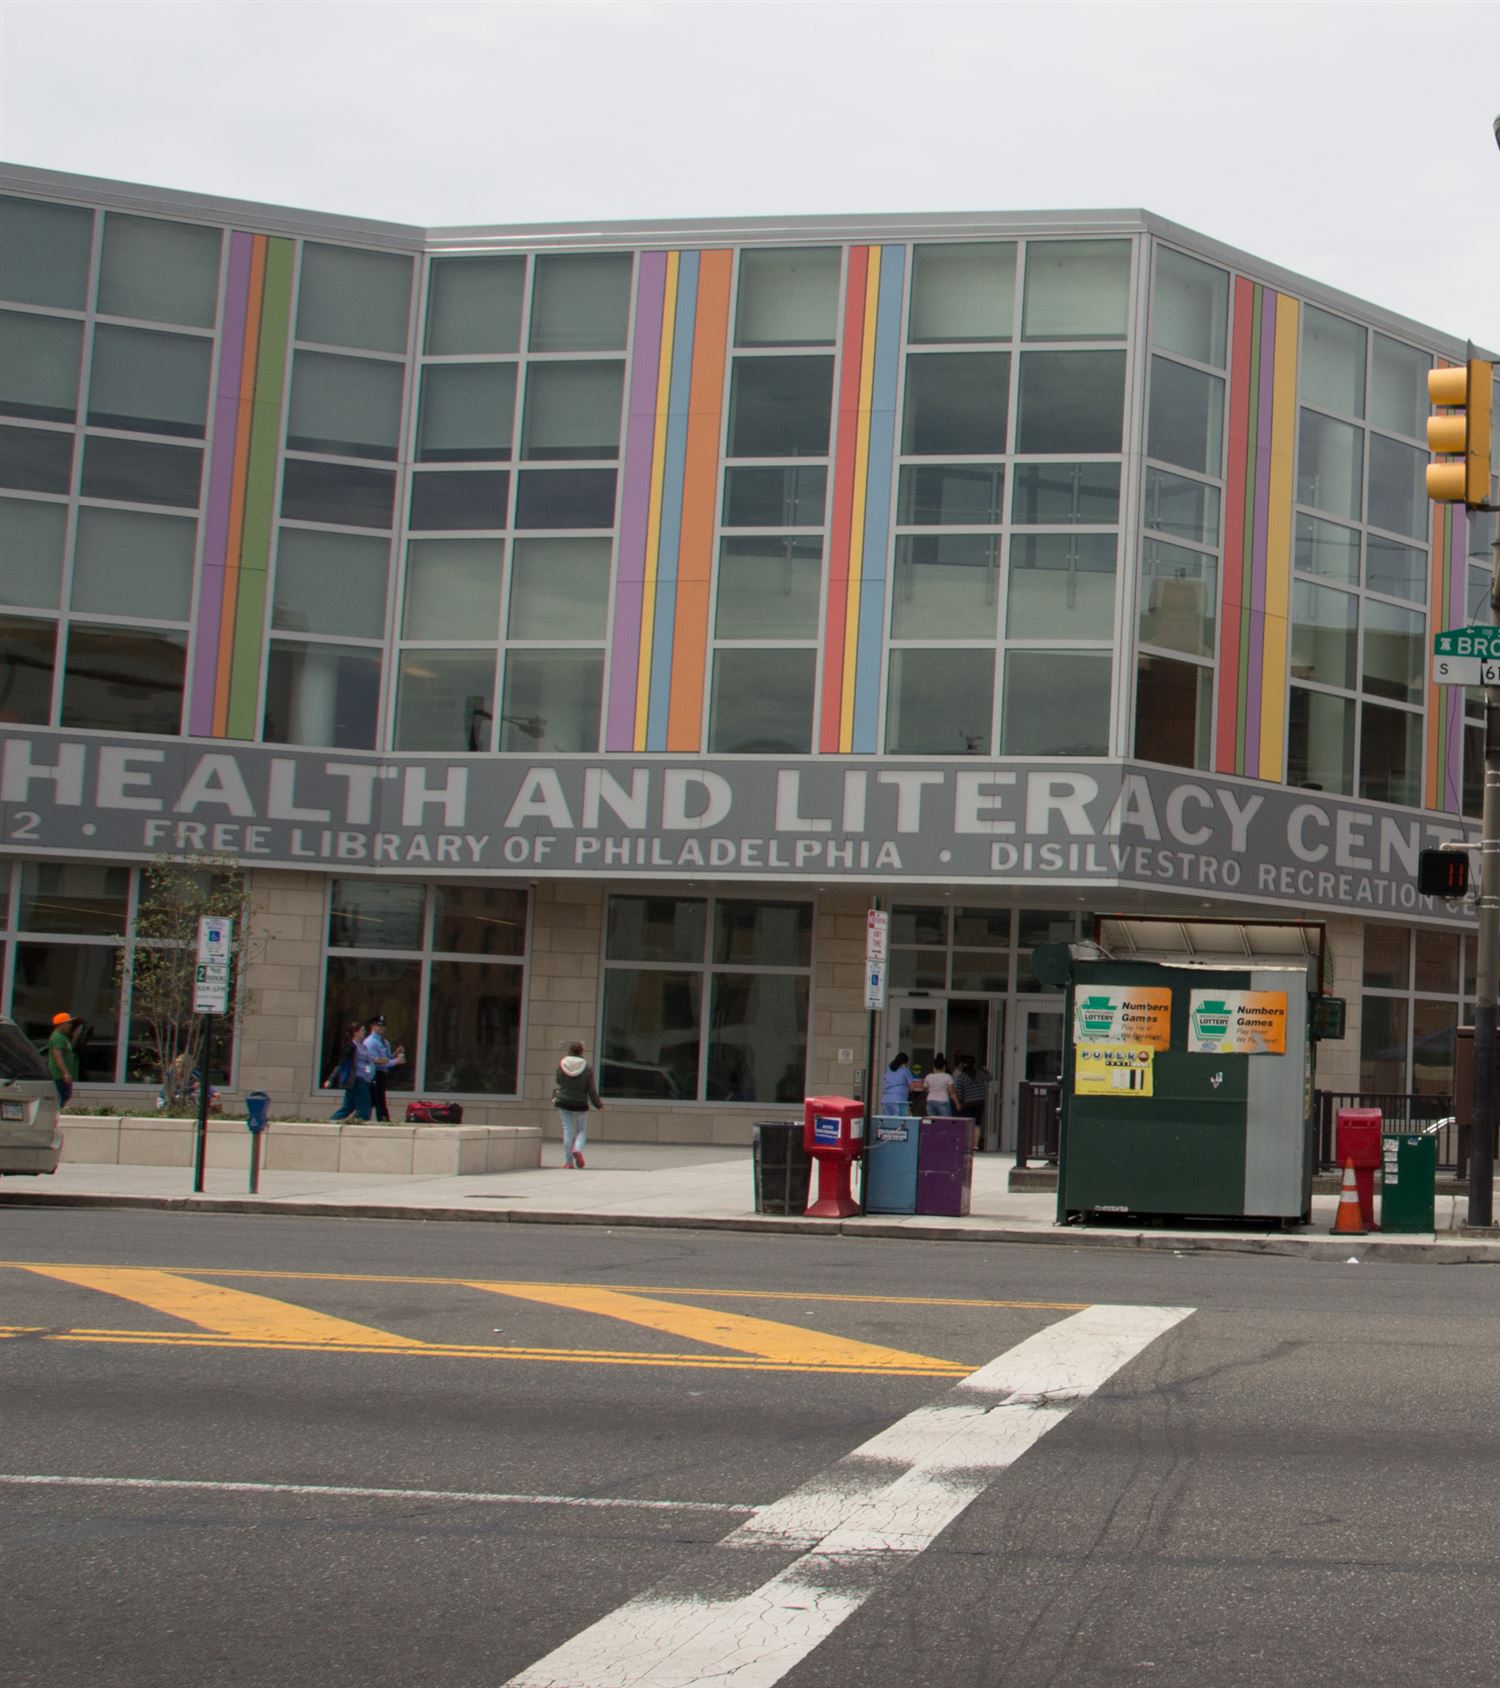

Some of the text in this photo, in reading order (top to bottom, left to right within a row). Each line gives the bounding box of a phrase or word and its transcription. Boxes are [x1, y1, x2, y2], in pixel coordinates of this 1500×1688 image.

[1439, 663, 1449, 675] S
[1, 738, 468, 827] HEALTH
[504, 766, 733, 830] AND
[775, 768, 1265, 853] LITERACY
[10, 811, 42, 840] 2
[143, 819, 272, 853] FREE
[291, 828, 490, 863] LIBRARY
[504, 836, 556, 863] OF
[573, 836, 903, 869] PHILADELPHIA
[990, 842, 1241, 887] DISILVESTRO
[1258, 863, 1434, 911] RECREATION
[1121, 1001, 1169, 1012] Numbers
[1237, 1005, 1284, 1016] Numbers
[1121, 1013, 1158, 1023] Games
[1237, 1017, 1273, 1028] Games
